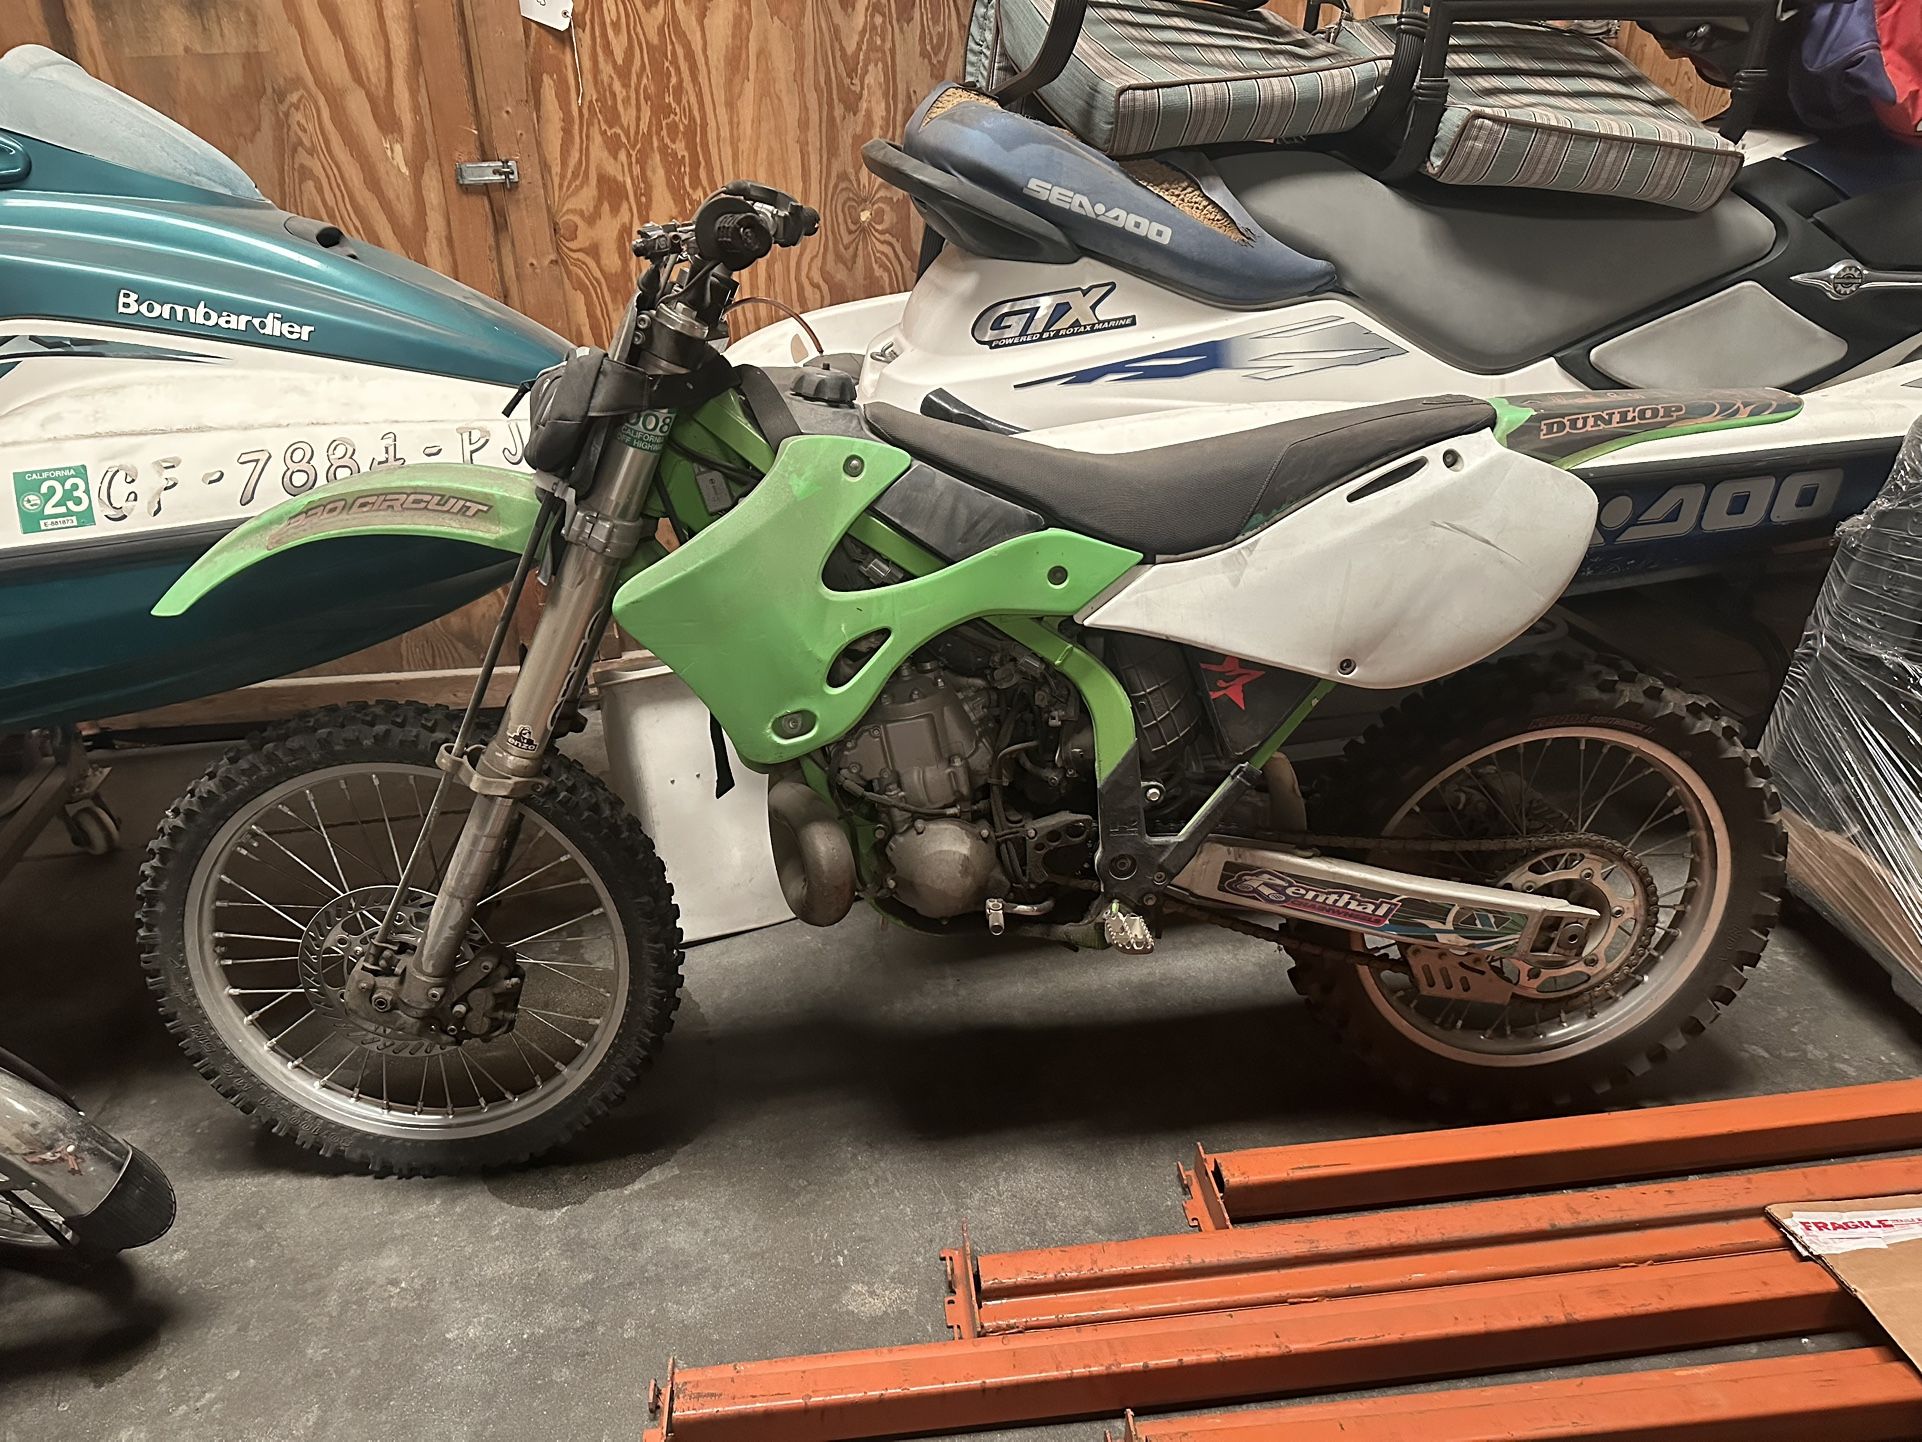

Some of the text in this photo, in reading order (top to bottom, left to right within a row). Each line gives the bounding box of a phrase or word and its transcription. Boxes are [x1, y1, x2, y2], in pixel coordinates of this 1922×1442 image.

[117, 289, 315, 342] Bombardier
[973, 284, 1114, 341] GTX
[991, 317, 1133, 347] POWERED BY ROTAX MARINE
[1540, 403, 1686, 439] DUNLOP
[25, 468, 76, 481] CALIFORNIA
[40, 477, 90, 516] 23
[348, 492, 494, 519] CIRCUIT
[1234, 873, 1394, 917] Renthal
[1799, 1219, 1894, 1232] FRAGILE
